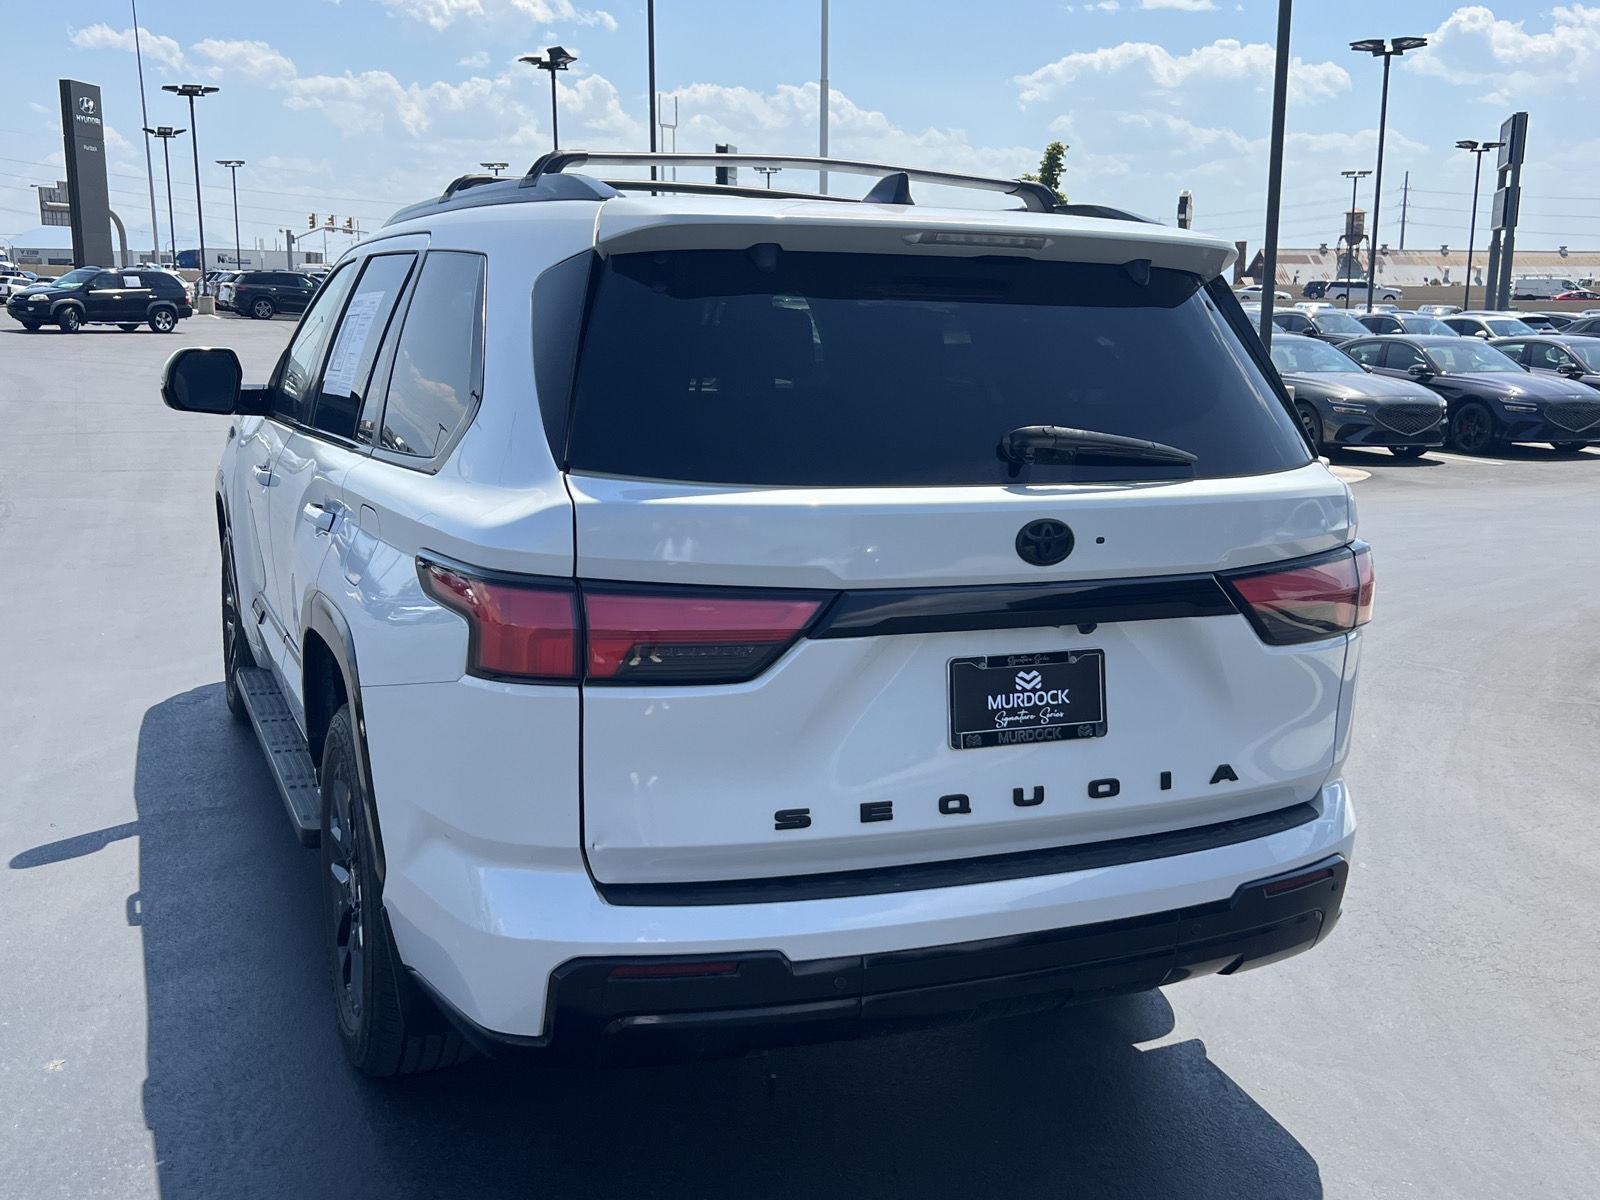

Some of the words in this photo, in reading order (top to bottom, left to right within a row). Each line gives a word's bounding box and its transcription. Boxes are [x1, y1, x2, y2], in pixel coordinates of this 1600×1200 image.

[76, 114, 101, 125] HYUNDAI
[987, 689, 1070, 710] MURDOCK
[995, 709, 1035, 728] Signature
[1039, 707, 1064, 725] Series
[998, 727, 1062, 744] MURDOCK
[774, 763, 1239, 830] SEQUOIA
